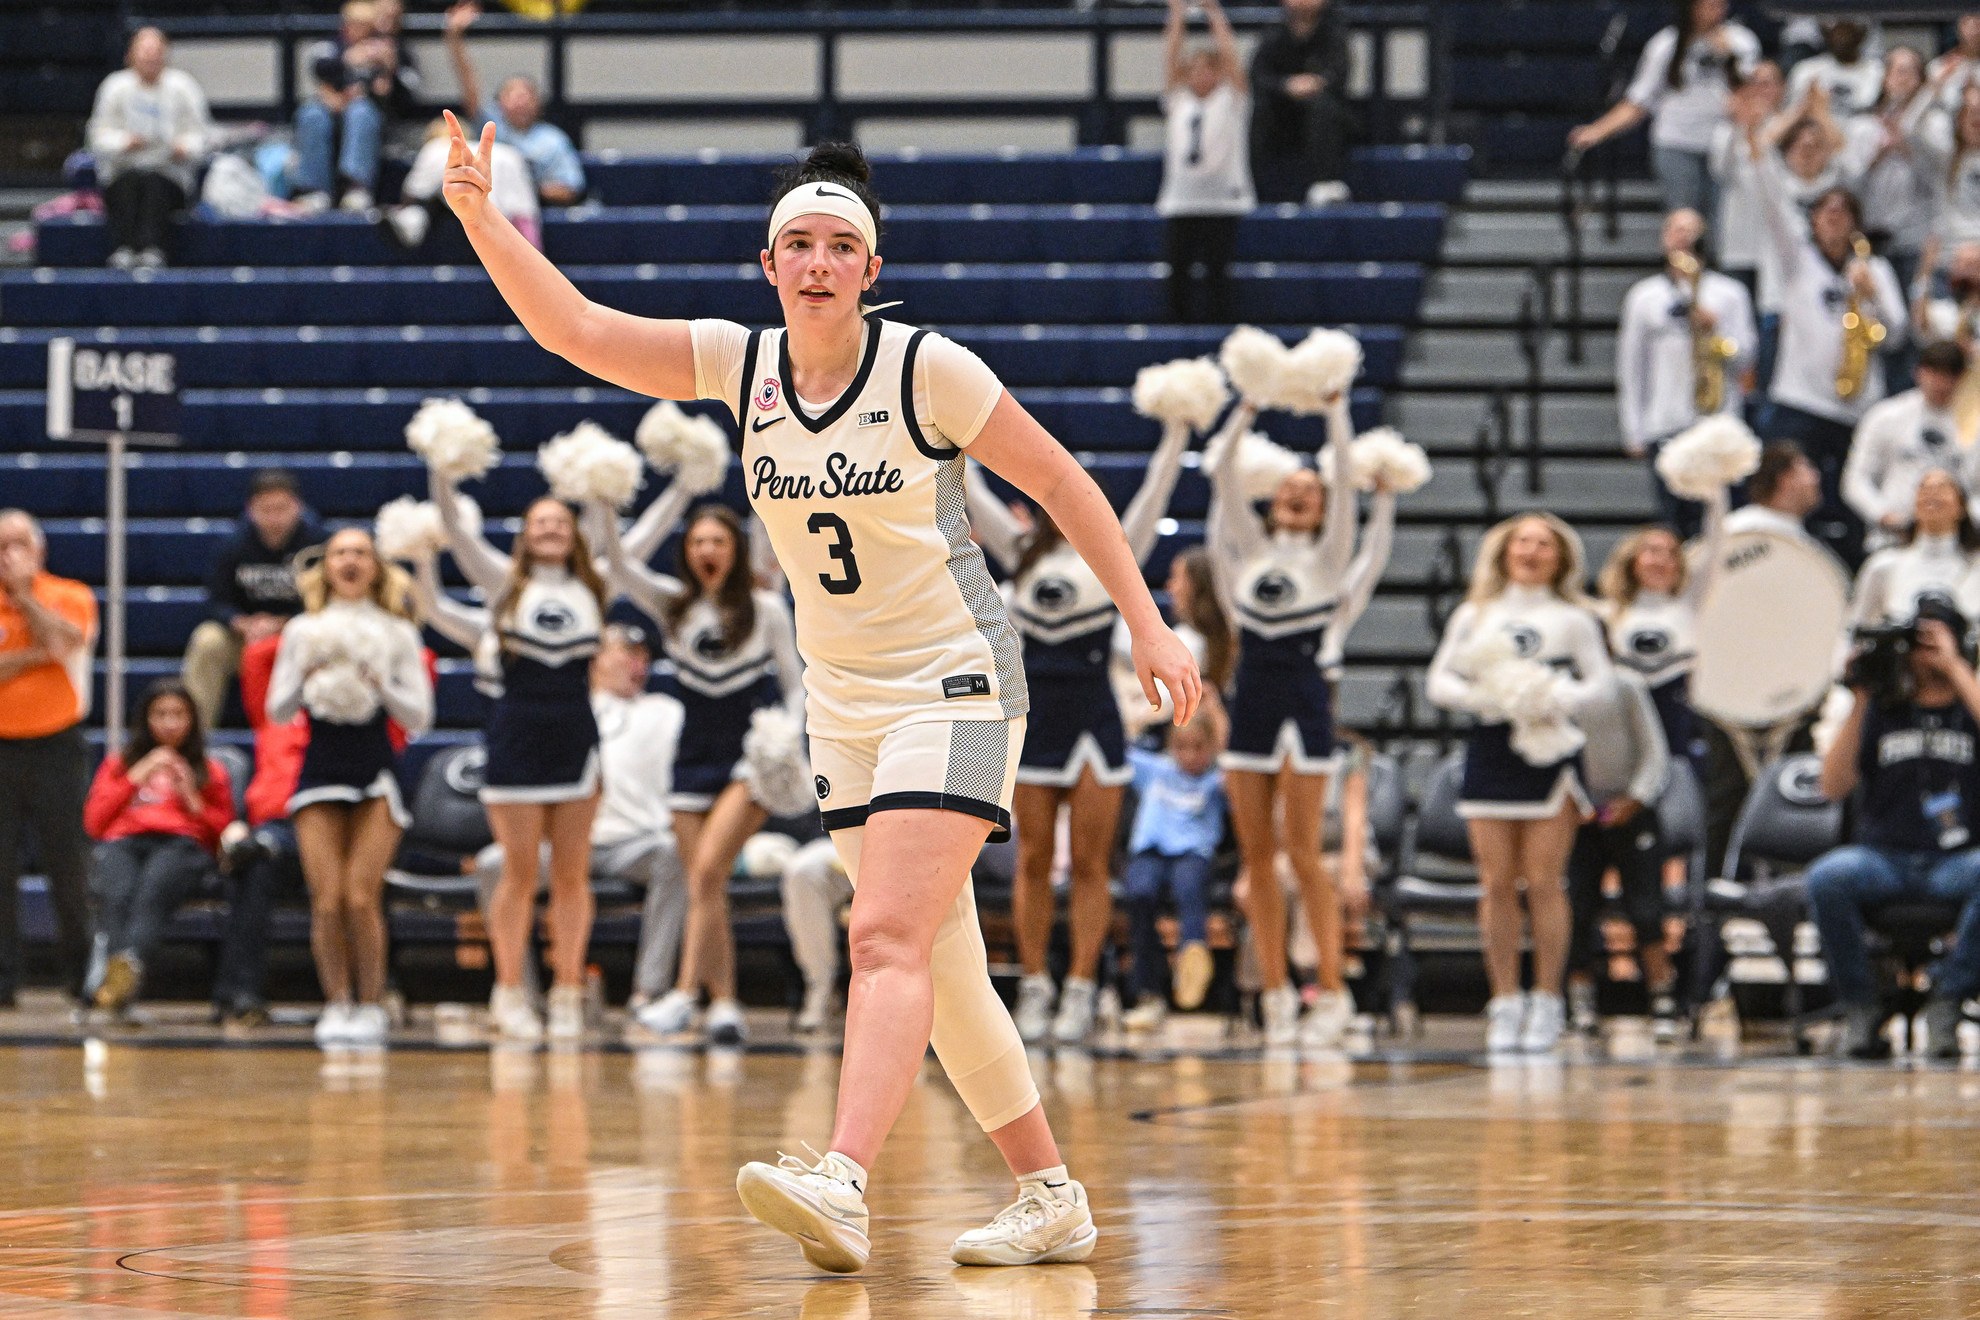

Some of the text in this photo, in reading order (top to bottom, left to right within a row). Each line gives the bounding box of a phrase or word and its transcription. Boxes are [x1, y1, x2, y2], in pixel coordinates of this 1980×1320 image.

[74, 349, 176, 394] BASE
[111, 394, 134, 430] 1
[751, 452, 904, 500] Penn State
[806, 512, 862, 595] 3
[975, 680, 984, 689] M
